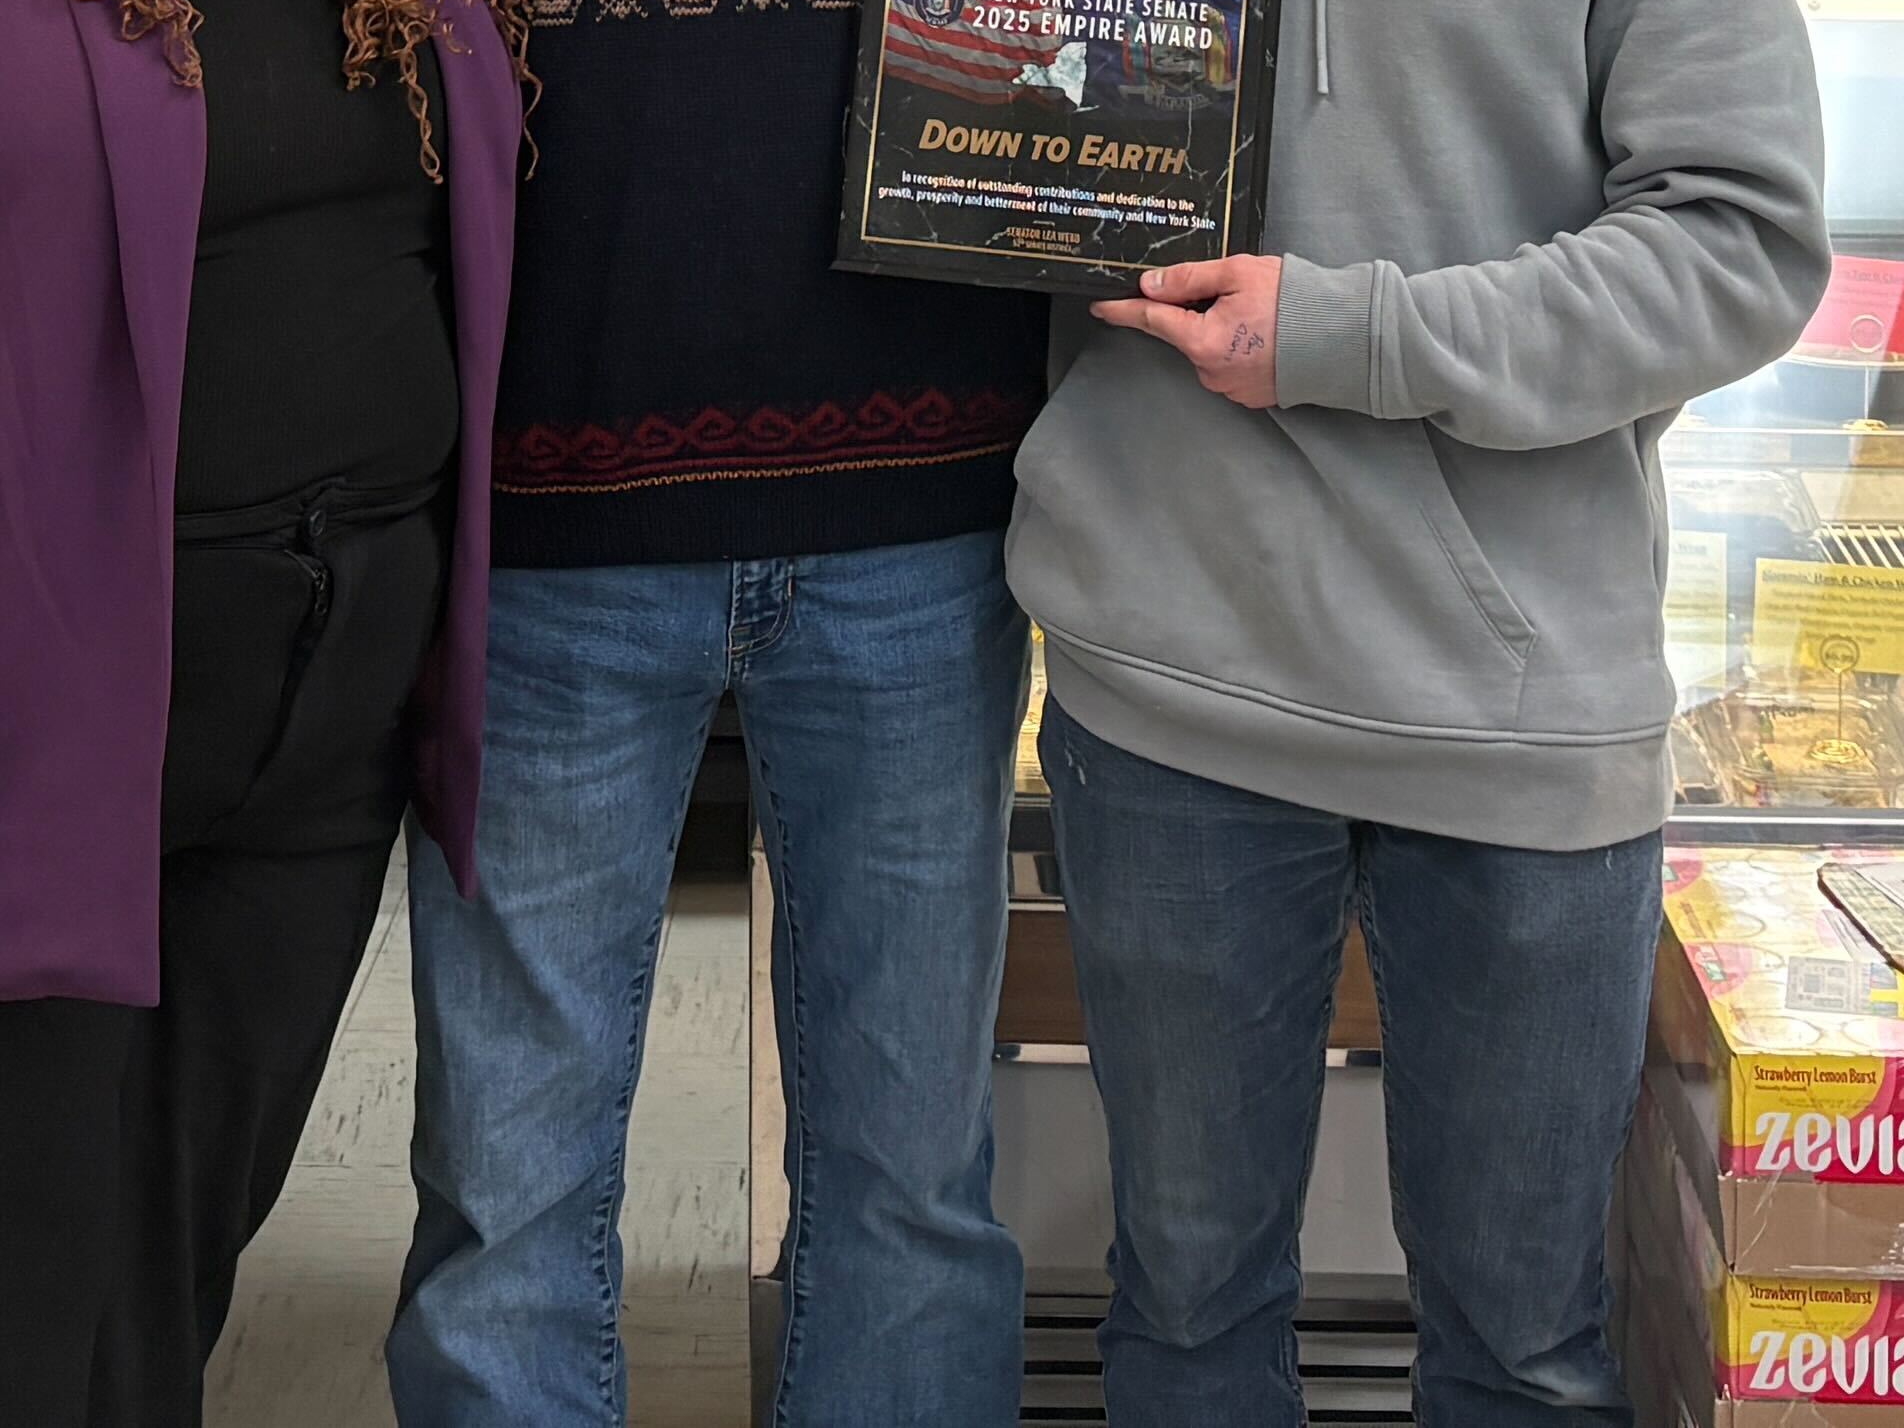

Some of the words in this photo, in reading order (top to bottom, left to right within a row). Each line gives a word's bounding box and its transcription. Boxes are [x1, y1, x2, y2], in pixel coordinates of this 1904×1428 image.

[972, 5, 1031, 33] 2025
[1040, 12, 1125, 42] EMPIRE
[1134, 21, 1213, 50] AWARD
[918, 118, 1025, 159] DOWN
[1031, 134, 1070, 163] TO
[1077, 134, 1187, 175] EARTH
[1146, 210, 1167, 223] New
[1168, 213, 1189, 227] York
[1191, 216, 1216, 230] State
[1754, 1065, 1811, 1086] Strawberry
[1814, 1067, 1847, 1083] Lemon
[1849, 1068, 1876, 1084] Burst
